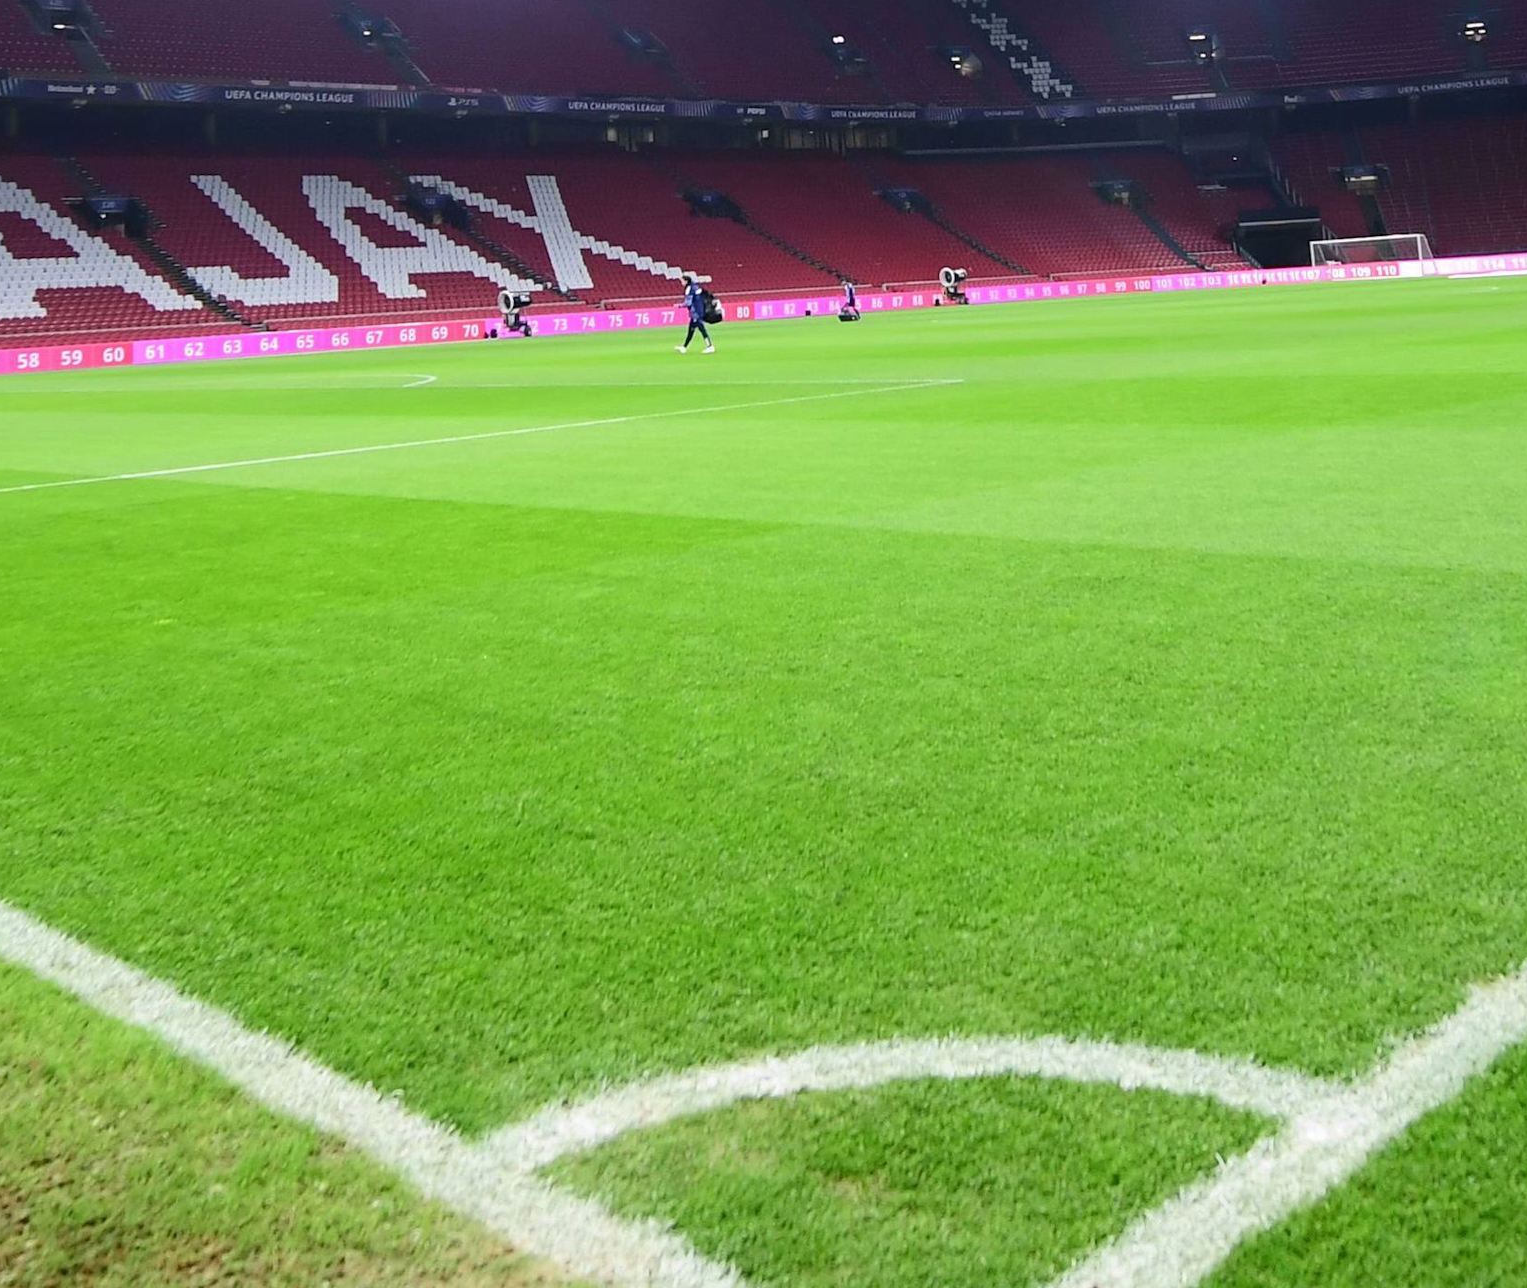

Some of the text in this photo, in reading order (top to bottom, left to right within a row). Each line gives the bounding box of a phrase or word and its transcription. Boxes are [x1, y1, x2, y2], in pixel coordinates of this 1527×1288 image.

[1398, 78, 1510, 94] UEFA CHAMPIONS LEAGUE
[225, 89, 355, 104] UEFA CHAMPIONS LEAGUE
[569, 102, 666, 113] UEFA CHAMPIONS LEAGUE
[18, 353, 39, 368] 58
[61, 350, 82, 365] 59
[103, 347, 124, 362] 60
[145, 345, 164, 359] 61
[184, 342, 203, 357] 62
[223, 340, 242, 354] 63
[260, 338, 278, 351] 64
[297, 335, 314, 349] 65
[332, 333, 349, 346] 66
[366, 331, 383, 344] 67
[400, 329, 416, 342] 68
[432, 327, 448, 340] 69
[463, 324, 478, 337] 70
[554, 318, 567, 331] 73
[582, 317, 595, 328] 74
[609, 315, 623, 327] 75
[636, 313, 649, 324] 76
[662, 311, 675, 323] 77
[737, 307, 749, 318] 80
[762, 305, 772, 316] 81
[784, 303, 795, 314] 82
